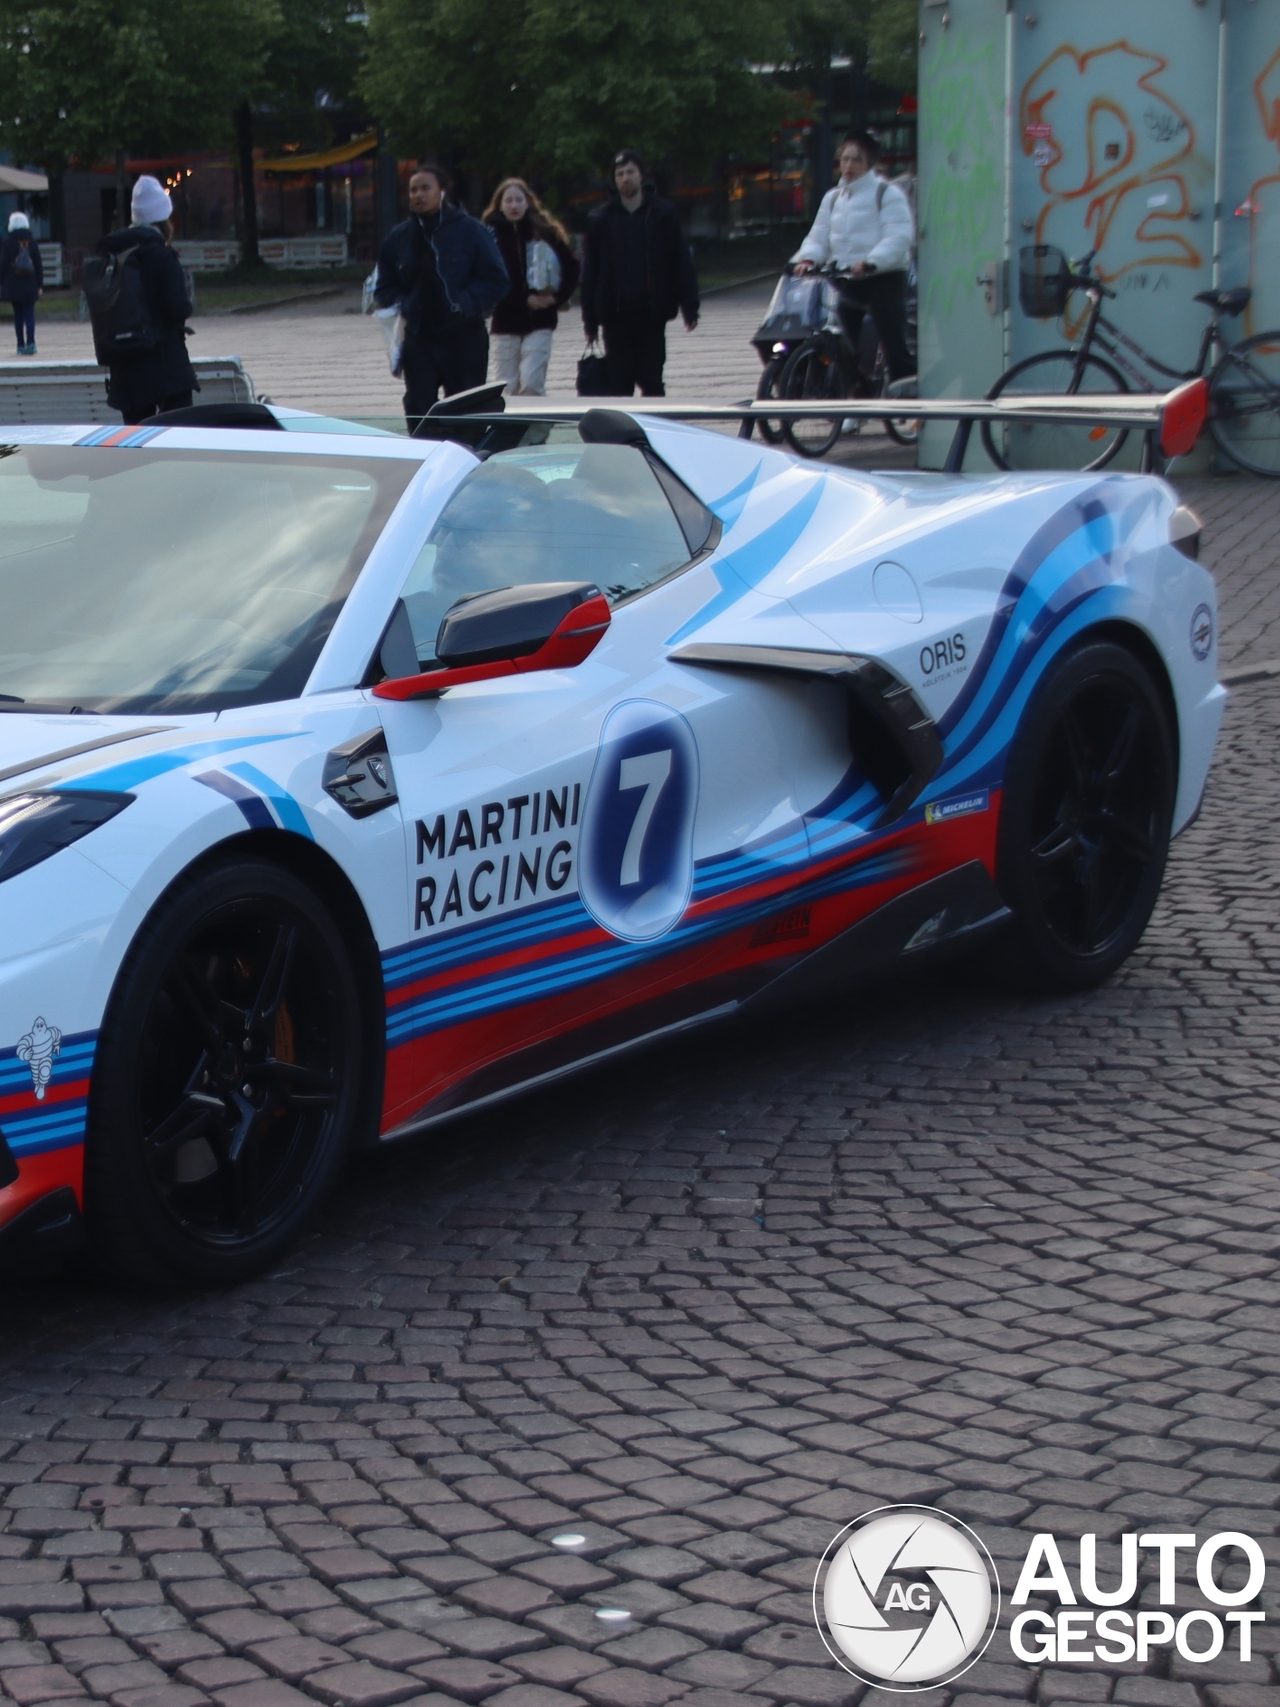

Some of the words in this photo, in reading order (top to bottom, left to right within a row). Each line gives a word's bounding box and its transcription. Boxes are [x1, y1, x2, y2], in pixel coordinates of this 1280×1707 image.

[919, 632, 966, 675] ORIS
[414, 782, 581, 866] MARTINI
[618, 748, 672, 887] 7
[942, 797, 984, 815] MICHELIN
[413, 839, 573, 932] RACING
